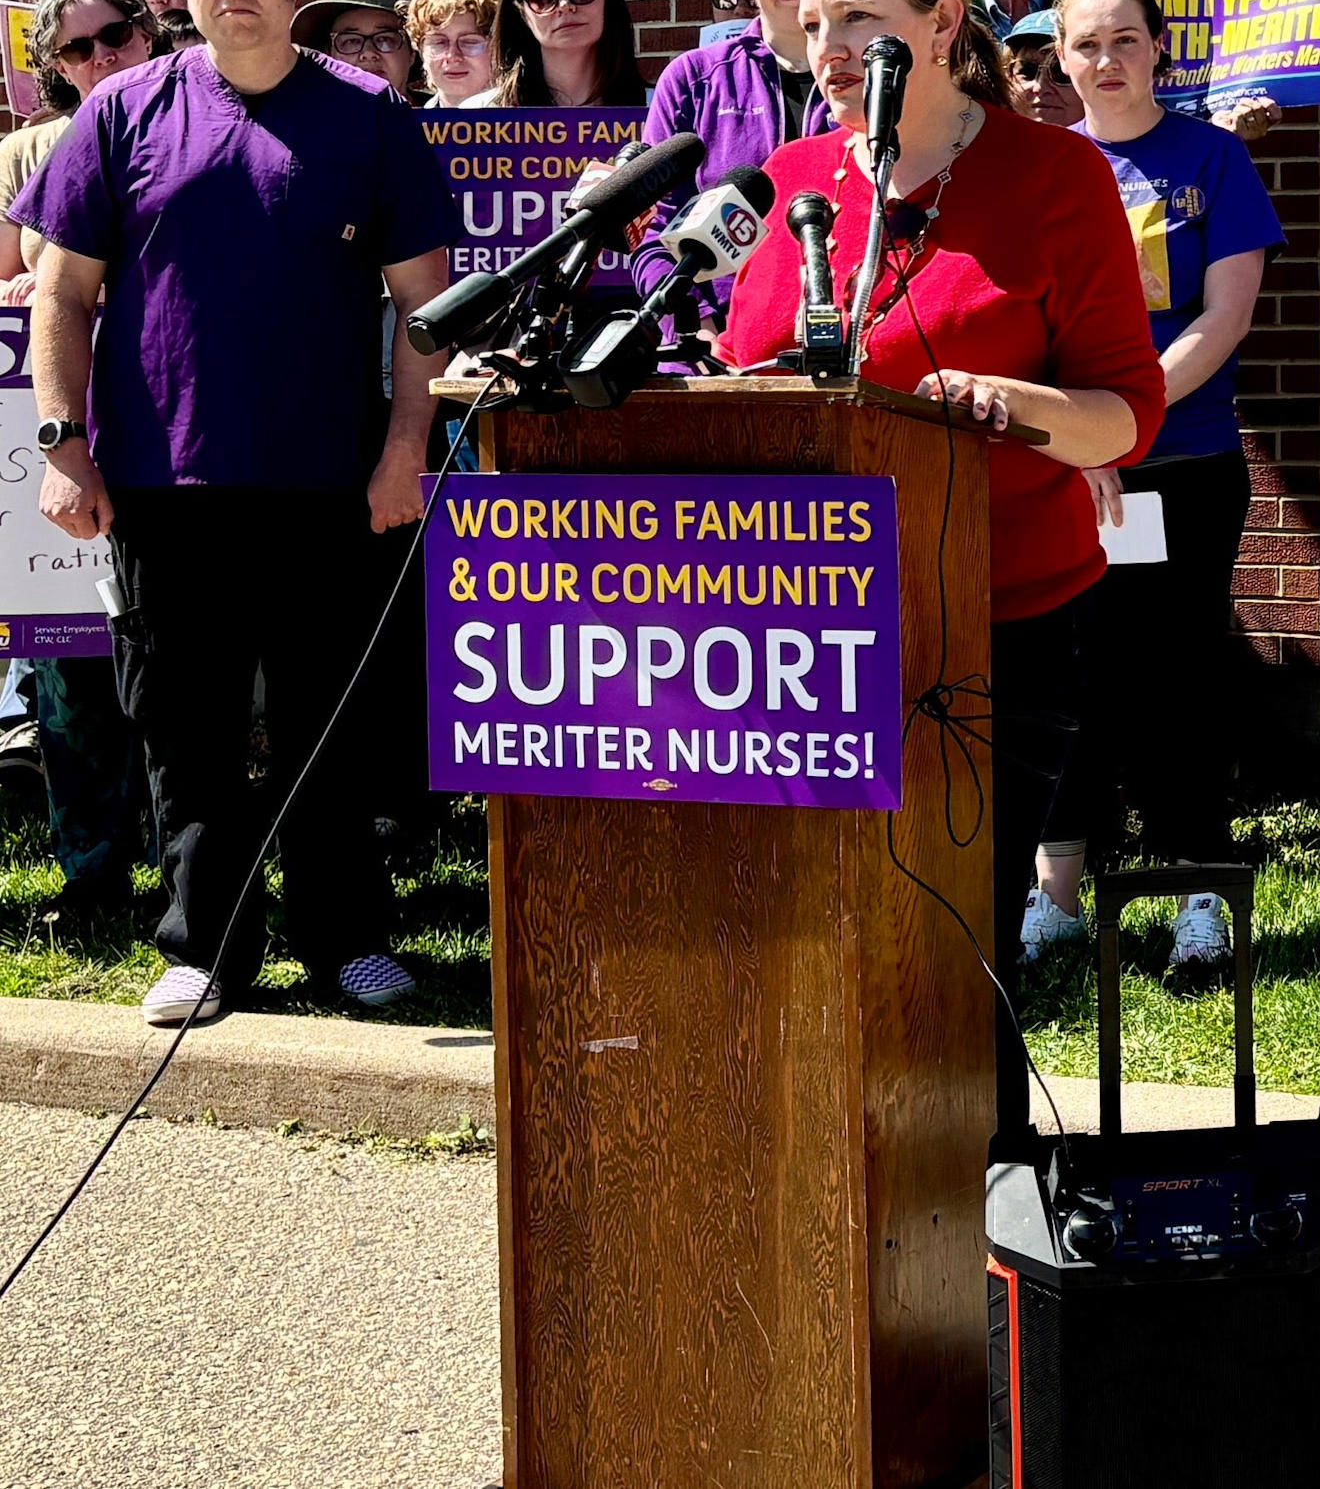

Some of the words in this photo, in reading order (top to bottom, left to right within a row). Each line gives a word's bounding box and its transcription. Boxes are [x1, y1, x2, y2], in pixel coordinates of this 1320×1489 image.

[1158, 61, 1231, 87] rontline
[1231, 50, 1295, 77] Workers
[421, 121, 568, 145] WORKING
[450, 157, 513, 180] OUR
[711, 224, 741, 260] WMTV
[729, 212, 756, 243] 15
[446, 498, 659, 540] WORKING
[675, 500, 872, 542] FAMILIES
[448, 557, 478, 603] &
[488, 561, 580, 603] OUR
[591, 563, 875, 607] COMMUNITY
[34, 625, 62, 635] Service
[63, 624, 105, 636] Employees
[453, 621, 876, 712] SUPPORT
[454, 721, 653, 772] MERITER
[668, 728, 875, 779] NURSES!
[1142, 1179, 1203, 1192] SPORT
